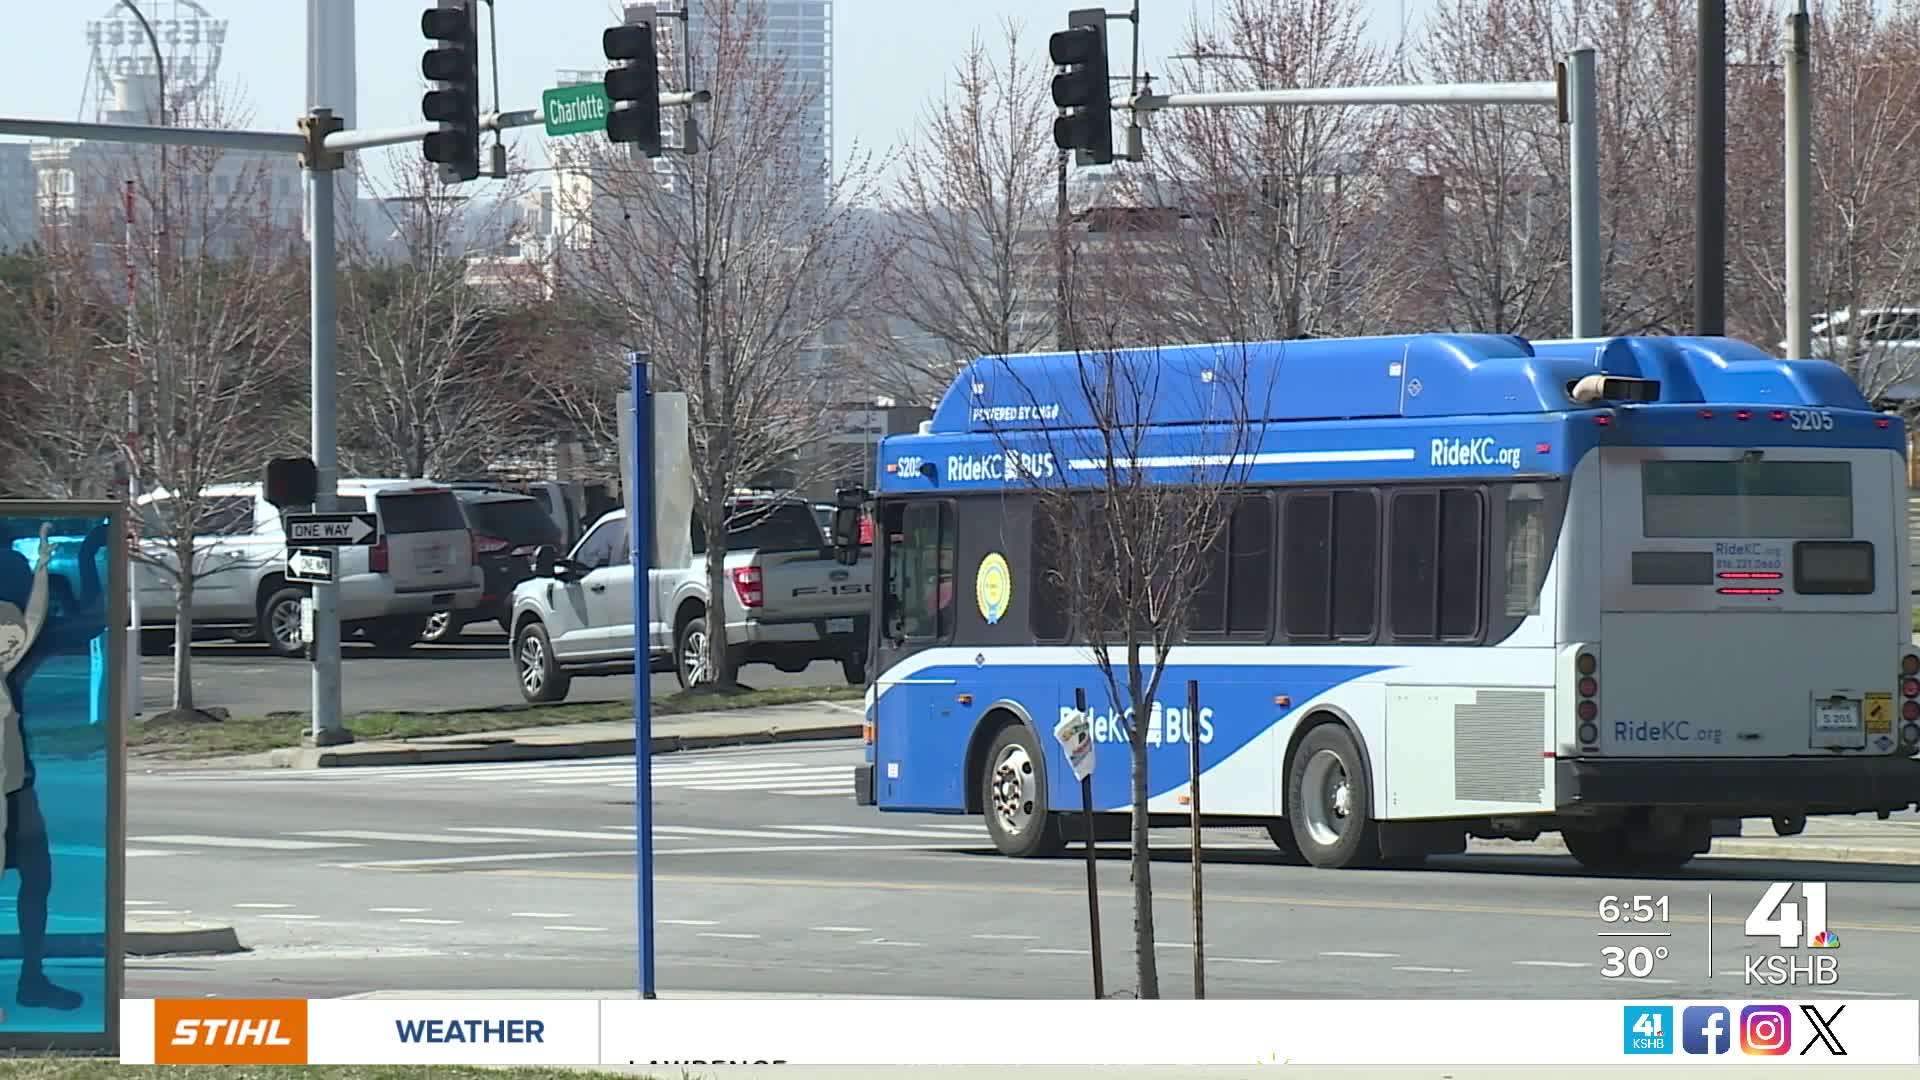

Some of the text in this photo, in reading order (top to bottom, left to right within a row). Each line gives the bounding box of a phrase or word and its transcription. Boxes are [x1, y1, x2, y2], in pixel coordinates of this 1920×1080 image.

[549, 94, 604, 125] Charlotte
[1018, 405, 1030, 420] BY
[1790, 410, 1833, 430] S205
[948, 452, 1054, 481] RideKC BUS
[1431, 437, 1520, 470] RideKC.org
[295, 524, 350, 537] ONE WAY
[1166, 707, 1214, 744] BUS
[1615, 721, 1722, 744] RideKC.org
